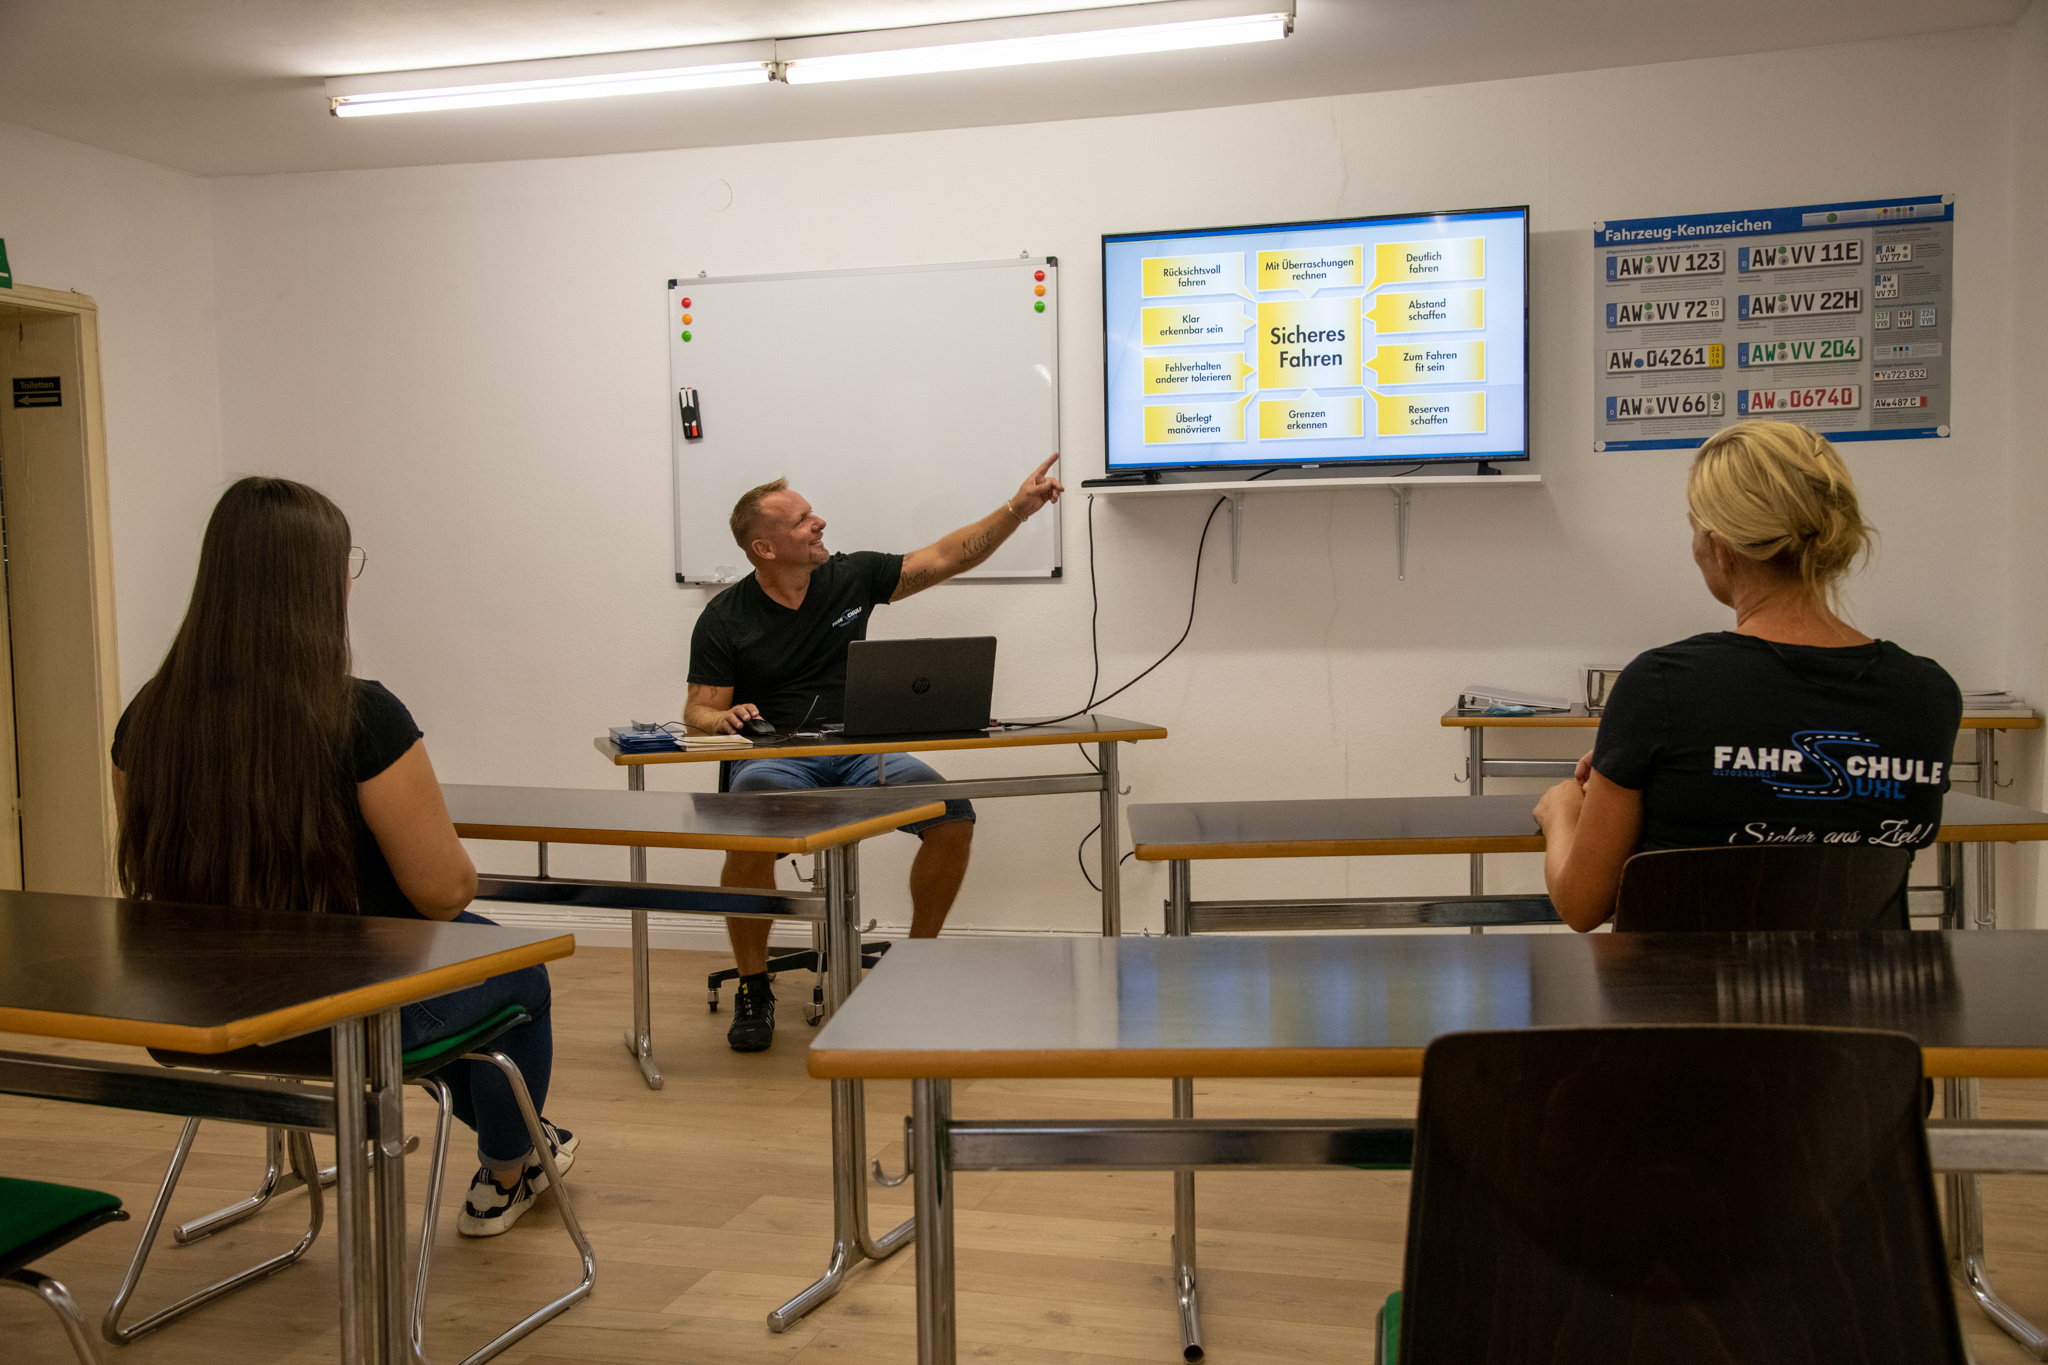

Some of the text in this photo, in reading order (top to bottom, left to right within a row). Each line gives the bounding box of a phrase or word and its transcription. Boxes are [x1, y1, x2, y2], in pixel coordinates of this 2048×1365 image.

[1605, 218, 1772, 242] Fahrzeug-Kennzeichen
[1406, 251, 1442, 262] Deutlich
[1752, 248, 1777, 267] AW
[1790, 245, 1816, 264] VV
[1820, 242, 1858, 262] 11E
[1879, 253, 1901, 262] VV 77
[1265, 258, 1354, 271] Mit Überraschungen
[1409, 263, 1439, 274] fahren
[1619, 257, 1643, 276] AW
[1657, 254, 1680, 273] VV
[1685, 252, 1720, 272] 123
[1163, 264, 1221, 277] Rücksichtsvoll
[1292, 270, 1327, 280] rechnen
[1178, 278, 1206, 287] fahren
[1408, 298, 1446, 309] Abstand
[1751, 296, 1776, 315] AW
[1790, 293, 1815, 312] VV
[1820, 290, 1858, 310] 22H
[1408, 310, 1447, 321] schaffen
[1619, 304, 1643, 323] AW
[1656, 302, 1680, 320] VV
[1684, 300, 1708, 318] 72
[1182, 314, 1201, 324] Klar
[1160, 324, 1224, 336] erkennbar sein
[1270, 324, 1346, 345] Sicheres
[1403, 350, 1458, 361] Zum Fahren
[1751, 343, 1776, 362] AW
[1790, 341, 1815, 360] VV
[1820, 339, 1856, 358] 204
[1279, 348, 1343, 368] Fahren
[1609, 347, 1706, 369] AW 04261
[1165, 361, 1222, 372] Fehlverhalten
[1415, 362, 1445, 372] fit sein
[1155, 373, 1232, 384] anderer tolerieren
[1909, 369, 1925, 378] 832
[19, 381, 54, 389] Toiletten
[1751, 391, 1776, 410] AW
[1790, 388, 1852, 408] 06740
[1892, 398, 1908, 407] 487
[1408, 405, 1450, 414] Reserven
[1619, 398, 1643, 416] AW
[1656, 396, 1680, 414] VV
[1682, 395, 1706, 413] 66
[1175, 412, 1213, 424] Überlegt
[1288, 409, 1326, 419] Grenzen
[1287, 420, 1328, 430] erkennen
[1410, 415, 1448, 425] schaffen
[1167, 424, 1221, 434] manövrieren
[1823, 829, 1862, 844] ans
[1868, 819, 1934, 847] Ziel!
